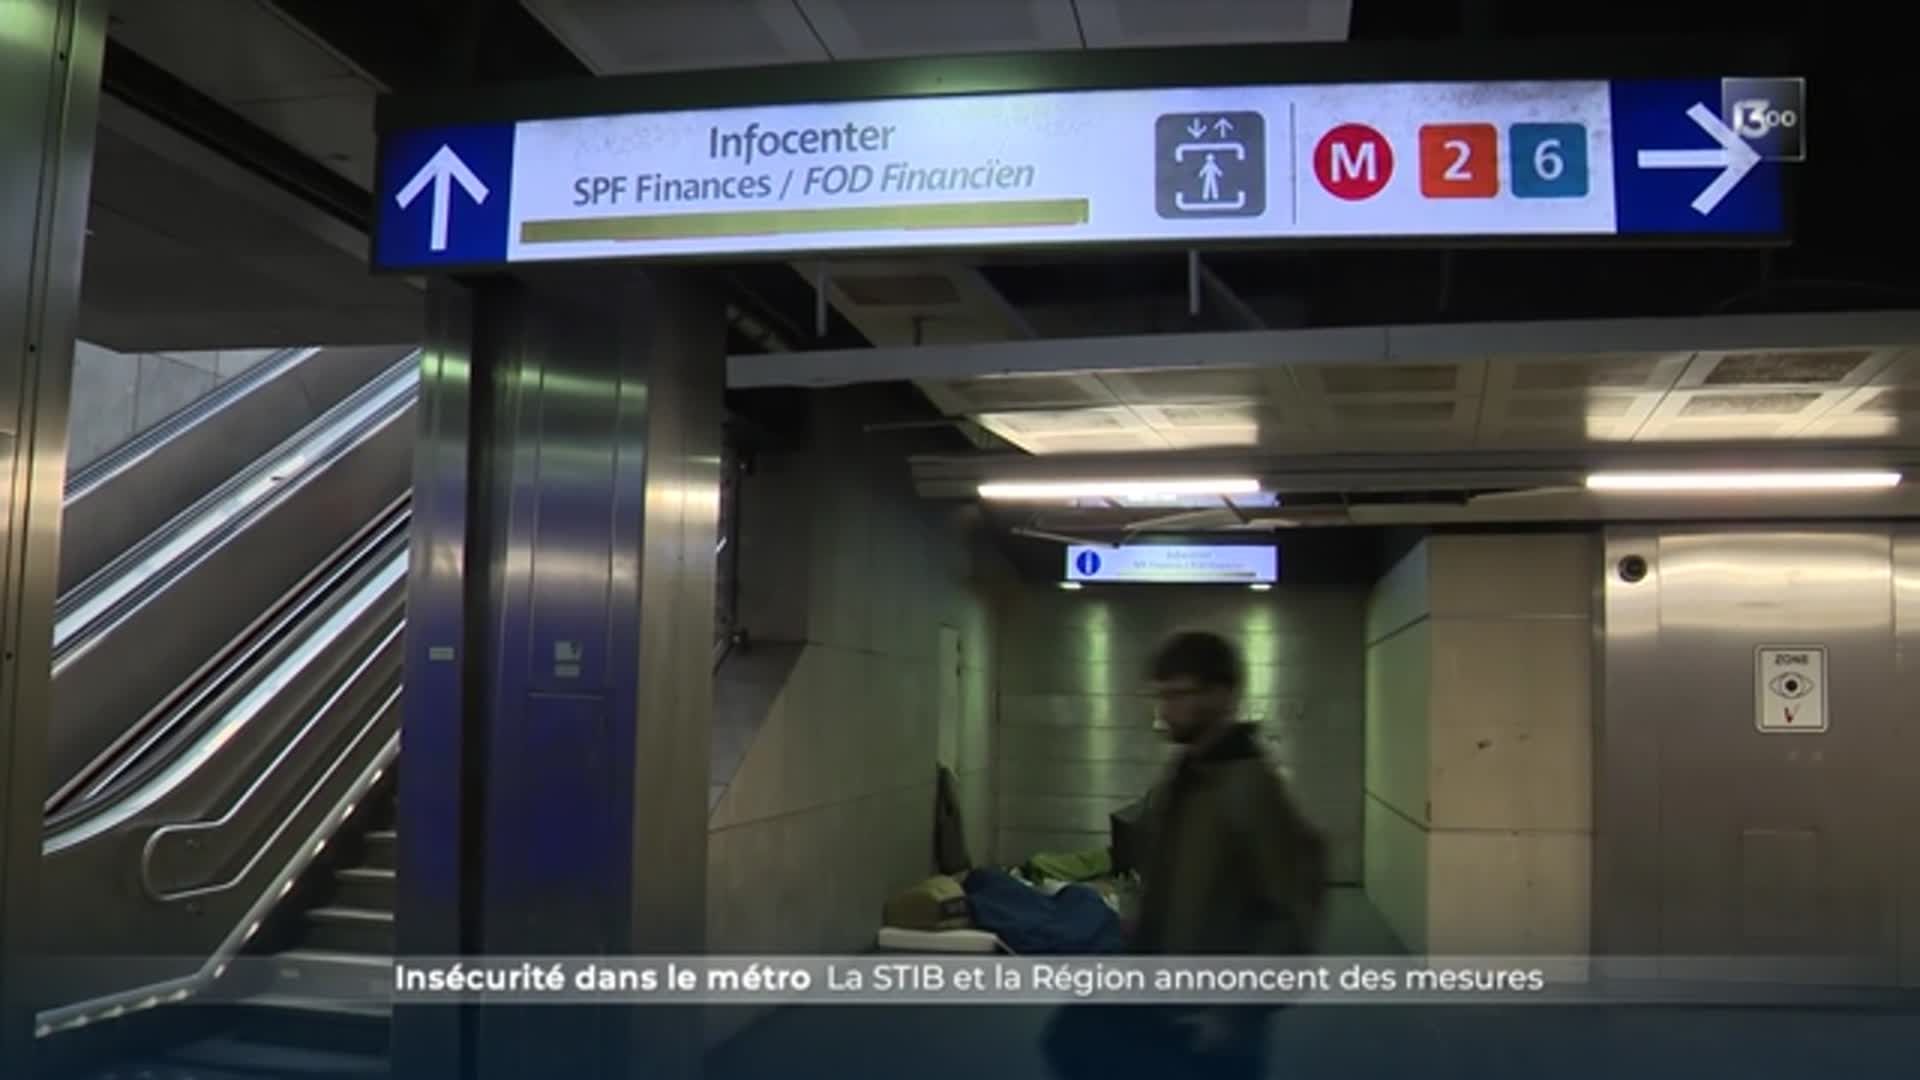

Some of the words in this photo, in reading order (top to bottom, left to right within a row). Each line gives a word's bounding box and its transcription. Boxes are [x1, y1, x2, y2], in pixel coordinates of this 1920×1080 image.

[709, 121, 895, 163] Infocenter
[1330, 142, 1376, 181] M
[1442, 140, 1472, 180] 2
[1534, 140, 1563, 180] 6
[573, 175, 628, 207] SPF
[636, 169, 772, 202] Finances
[779, 169, 793, 201] /
[803, 165, 873, 196] FOD
